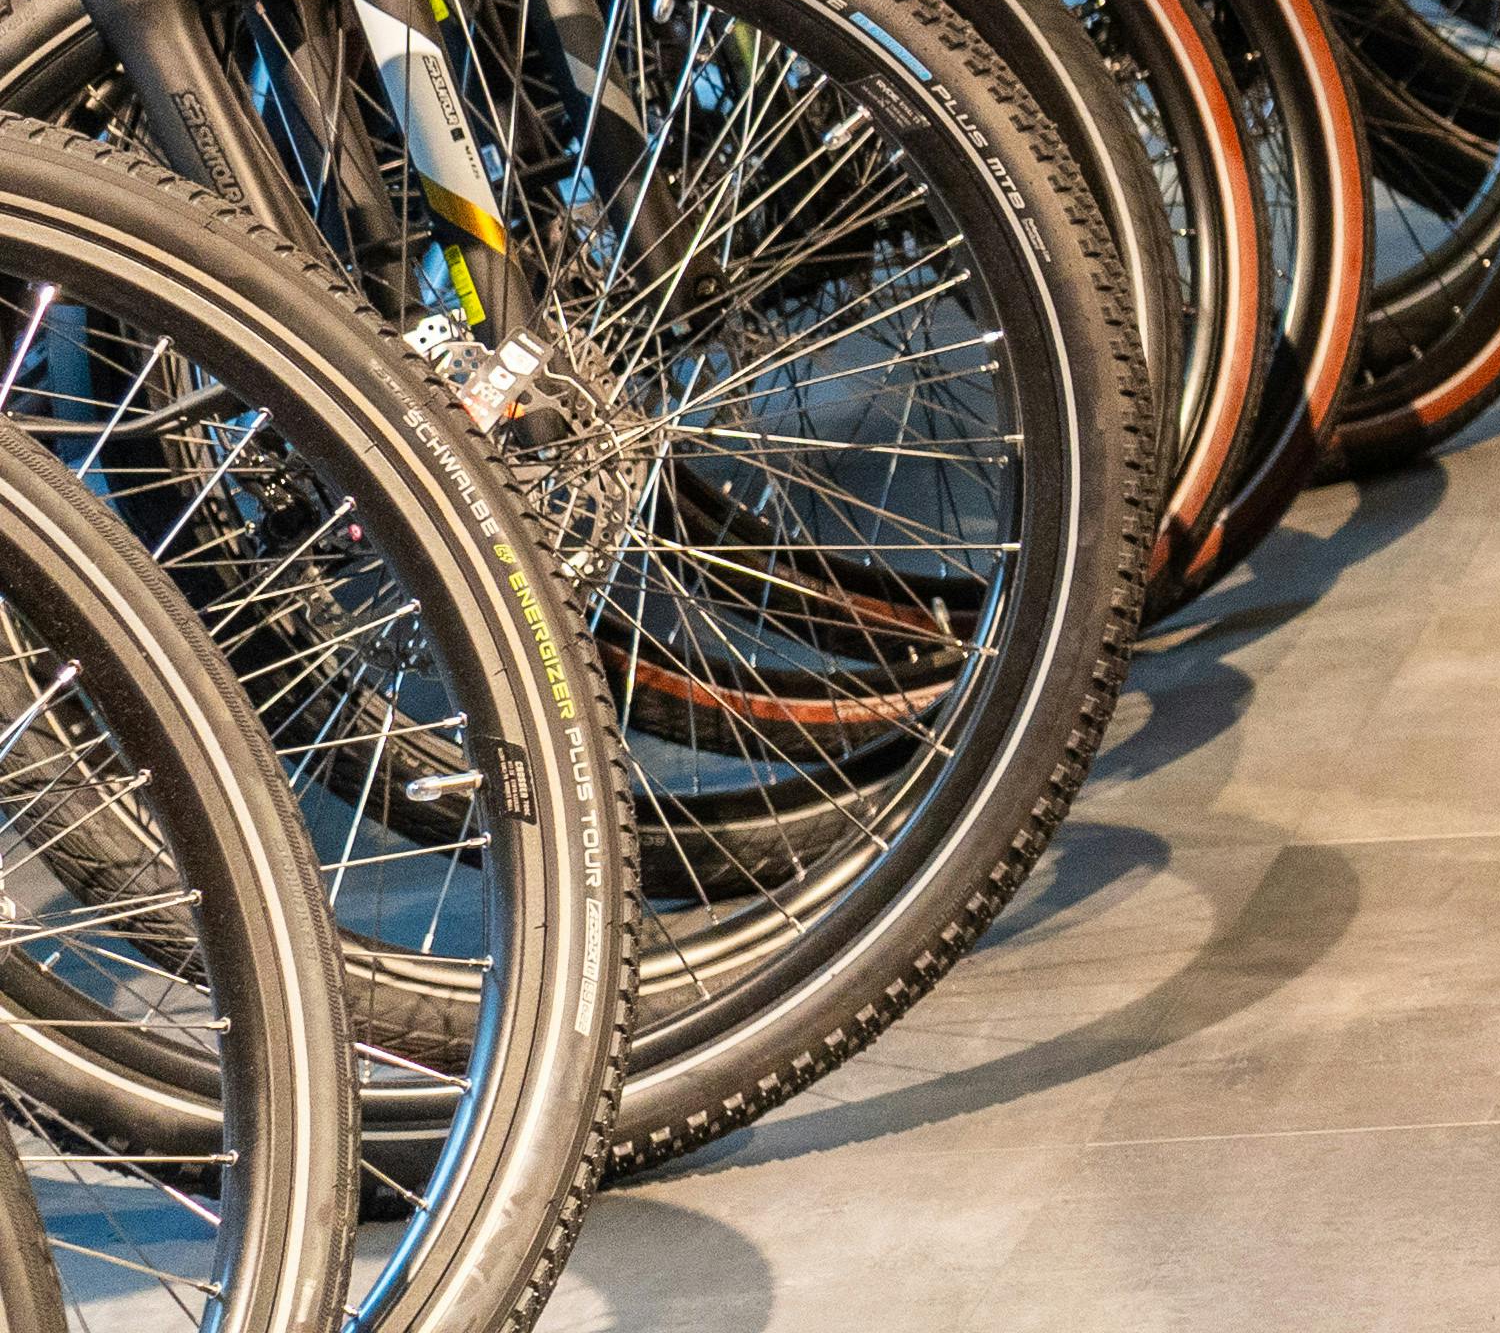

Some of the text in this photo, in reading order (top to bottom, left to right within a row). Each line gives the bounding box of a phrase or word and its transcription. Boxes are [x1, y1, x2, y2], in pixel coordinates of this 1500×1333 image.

[929, 83, 1026, 210] PLUS MTB
[402, 410, 501, 538] SCHWALBE
[508, 573, 576, 721] ENERGIZER
[564, 727, 594, 802] PLUS
[583, 811, 602, 895] TOUR
